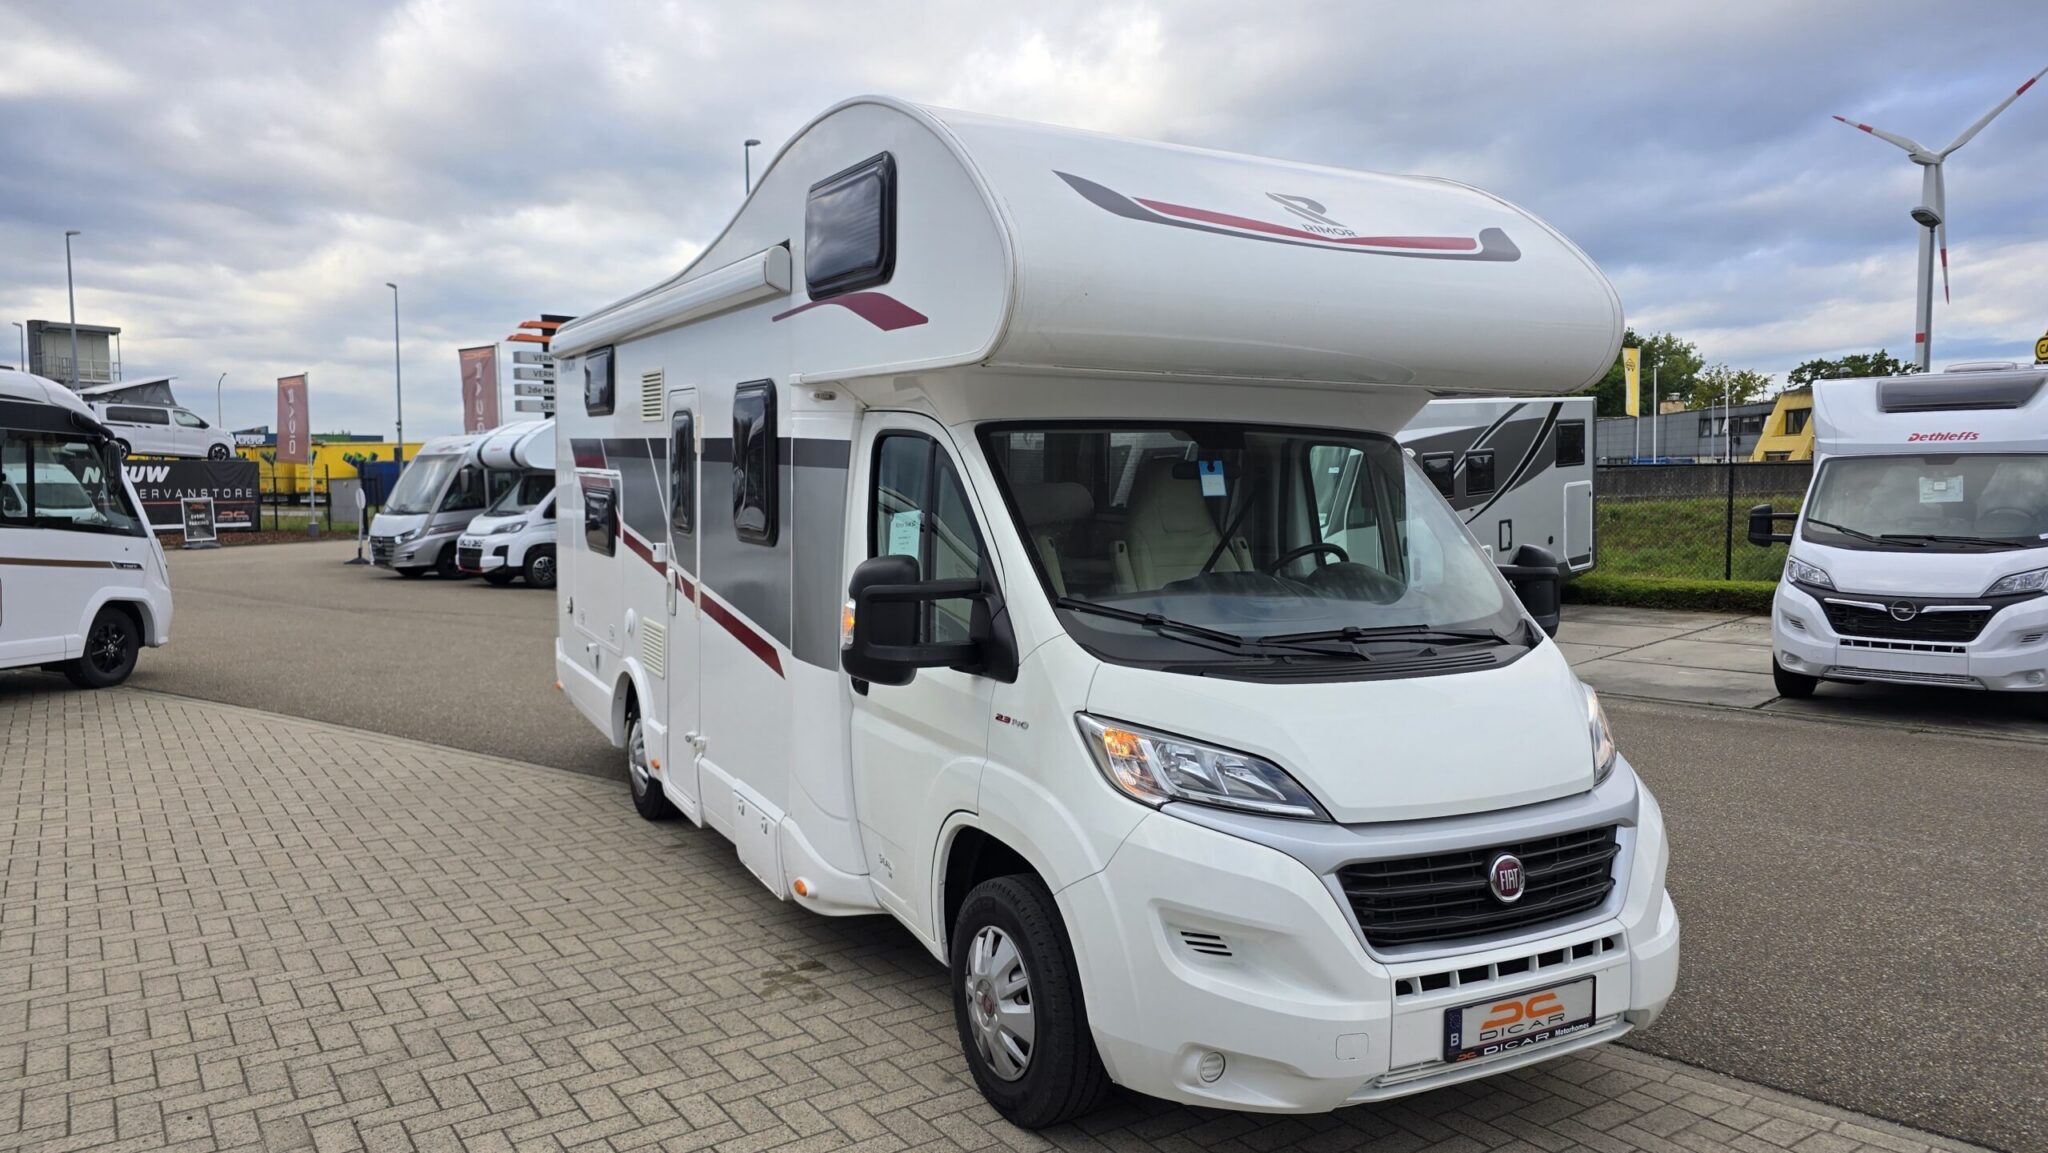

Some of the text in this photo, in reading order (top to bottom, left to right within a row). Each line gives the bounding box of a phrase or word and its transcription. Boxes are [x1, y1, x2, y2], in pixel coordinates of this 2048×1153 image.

[1302, 223, 1357, 238] RIMOR
[1908, 431, 1980, 442] Dethleffs
[82, 466, 170, 484] NUW
[1500, 868, 1518, 891] FIAT
[1479, 1013, 1565, 1042] DICAR
[1450, 1033, 1459, 1047] B
[1483, 1032, 1550, 1056] DICAR
[1555, 1022, 1590, 1037] Motorhomes
